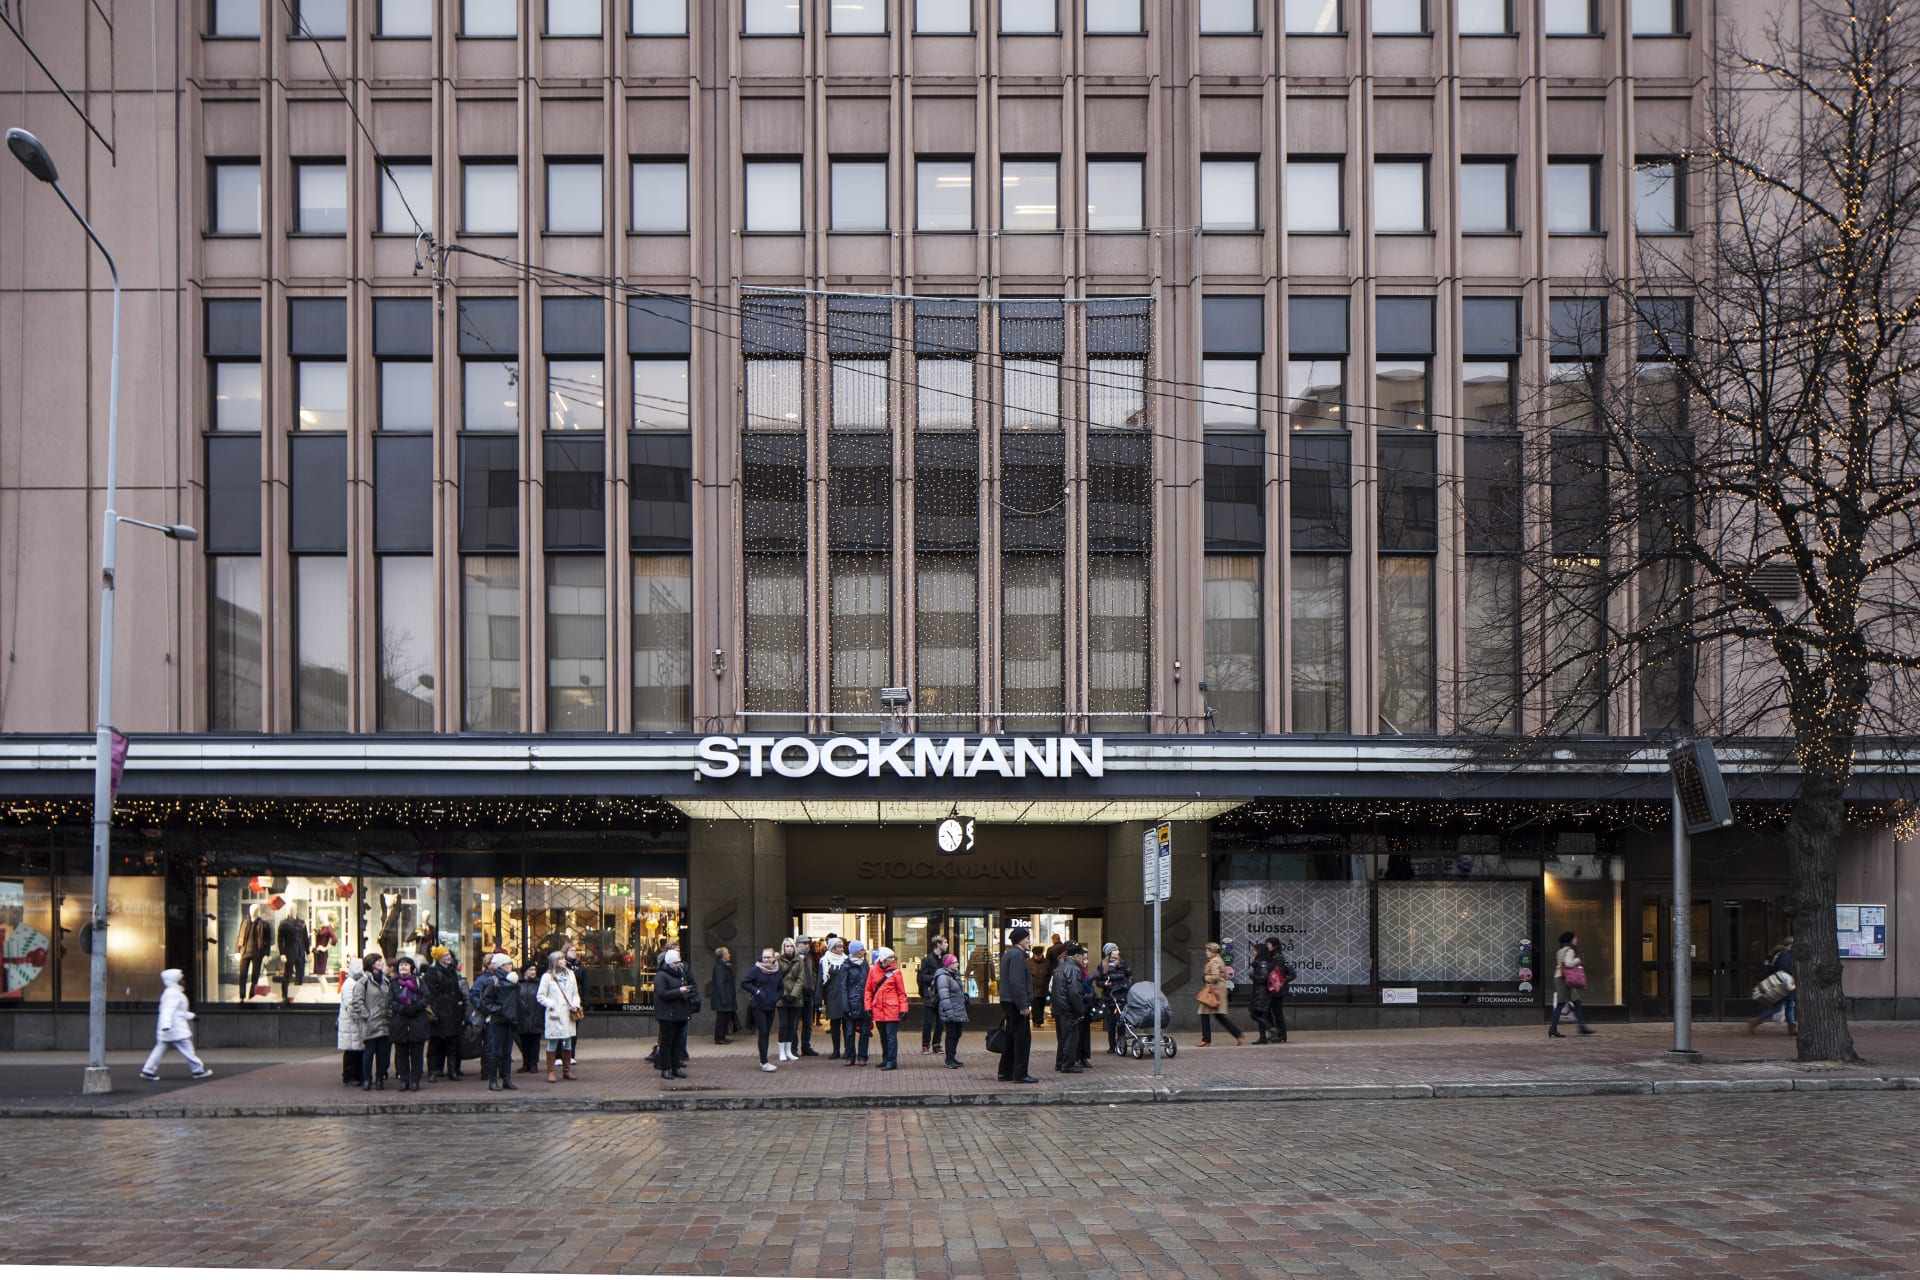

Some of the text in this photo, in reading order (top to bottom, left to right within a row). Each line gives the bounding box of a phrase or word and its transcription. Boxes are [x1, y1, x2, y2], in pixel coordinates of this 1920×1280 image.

[699, 736, 1104, 778] STOCKMANN
[856, 860, 1038, 880] STOCKMANN
[1247, 903, 1285, 915] Uutta
[1010, 918, 1032, 928] Dior
[1247, 920, 1308, 934] tulossa...
[1288, 986, 1328, 994] ANN.COM
